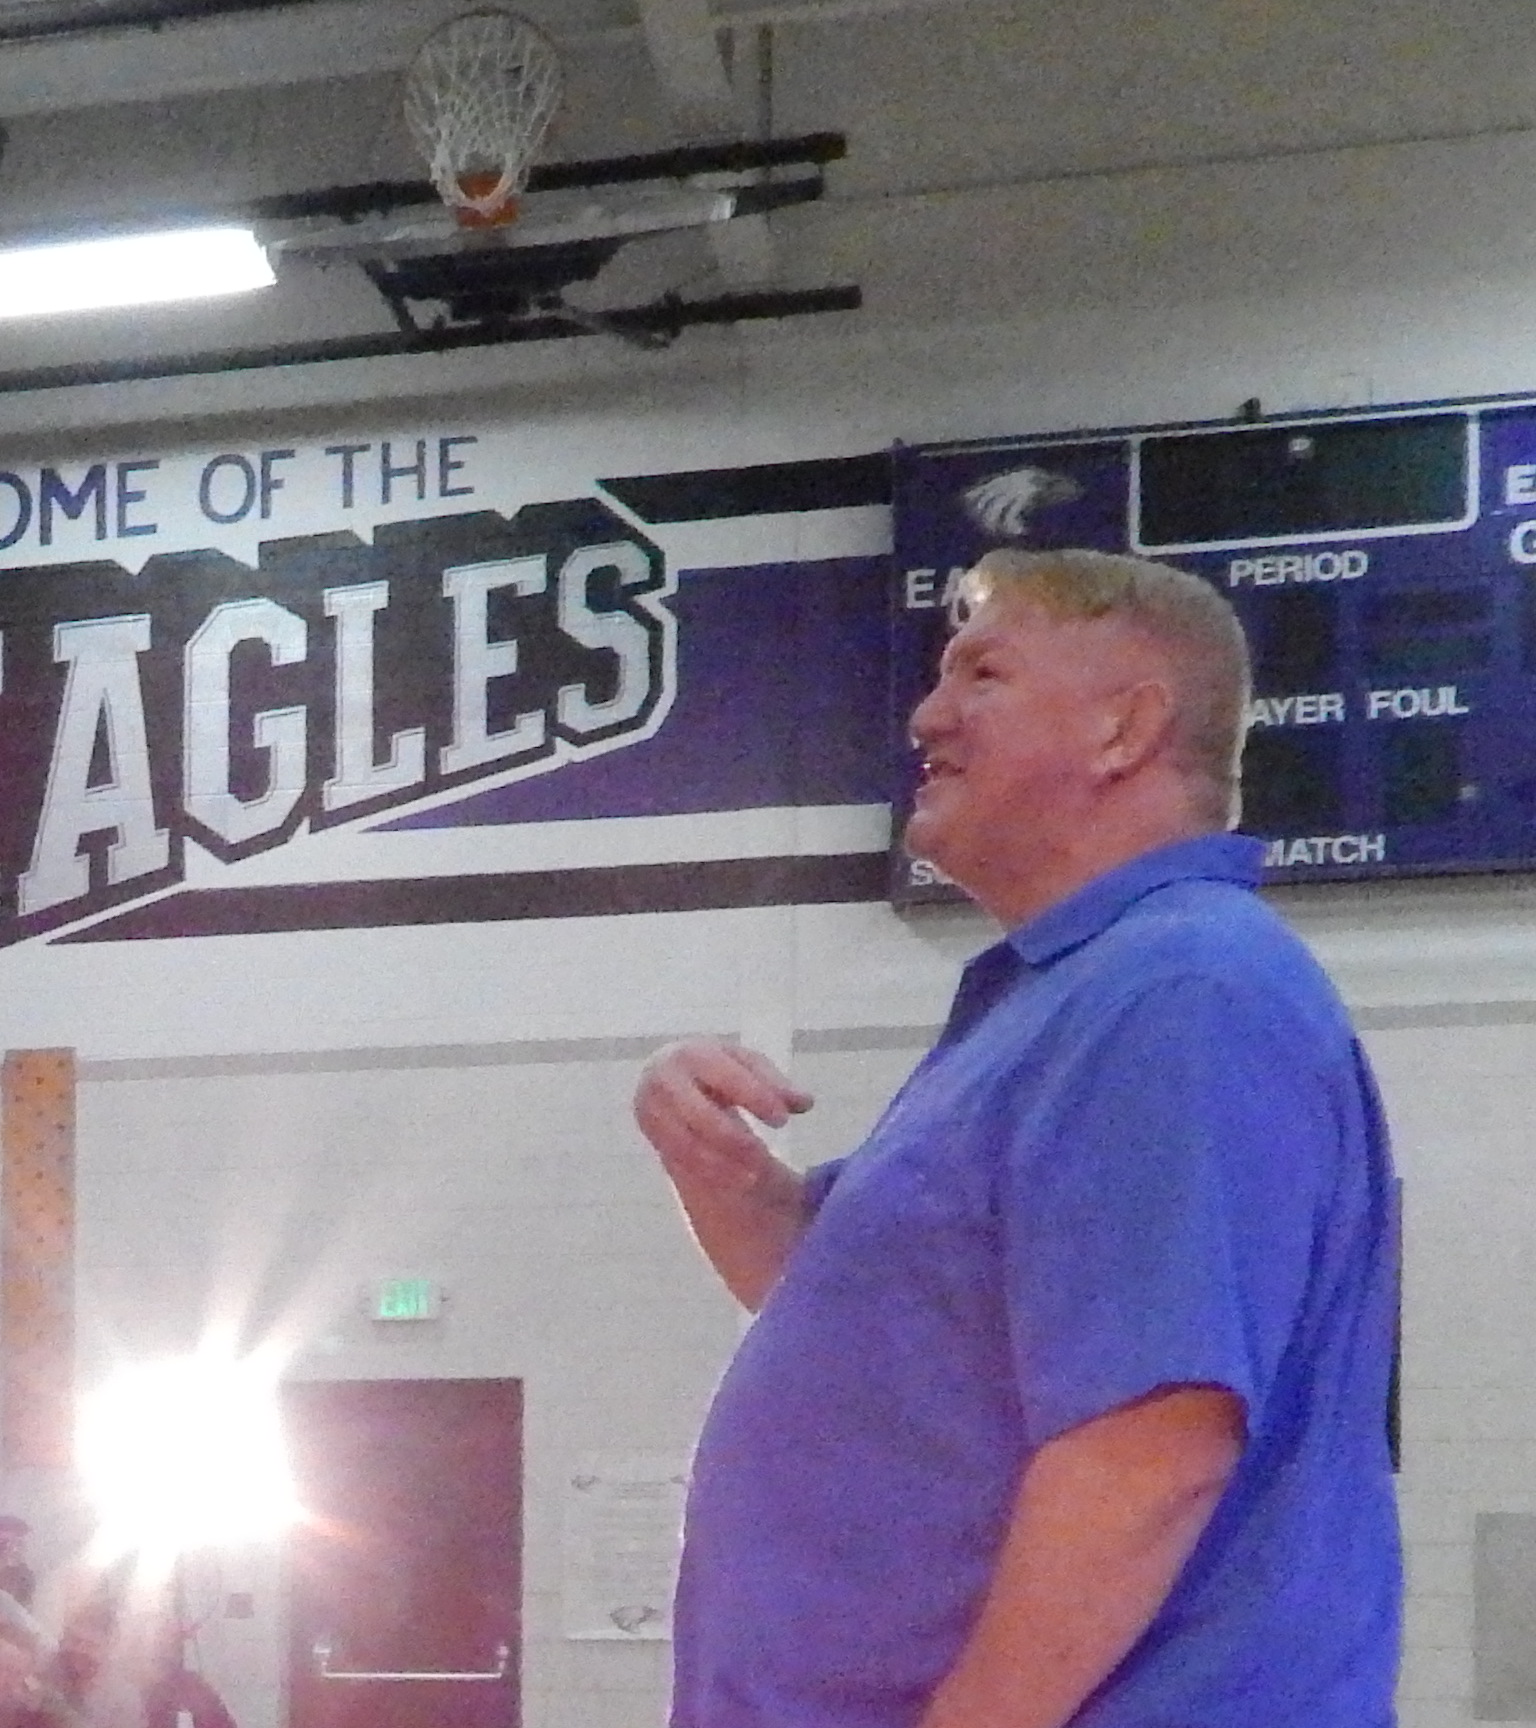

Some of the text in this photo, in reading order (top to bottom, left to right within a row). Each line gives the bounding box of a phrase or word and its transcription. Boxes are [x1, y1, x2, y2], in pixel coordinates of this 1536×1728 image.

[199, 449, 295, 524] OF
[325, 435, 478, 509] THE
[1229, 549, 1368, 588] PERIOD
[1367, 685, 1470, 720] FOUL
